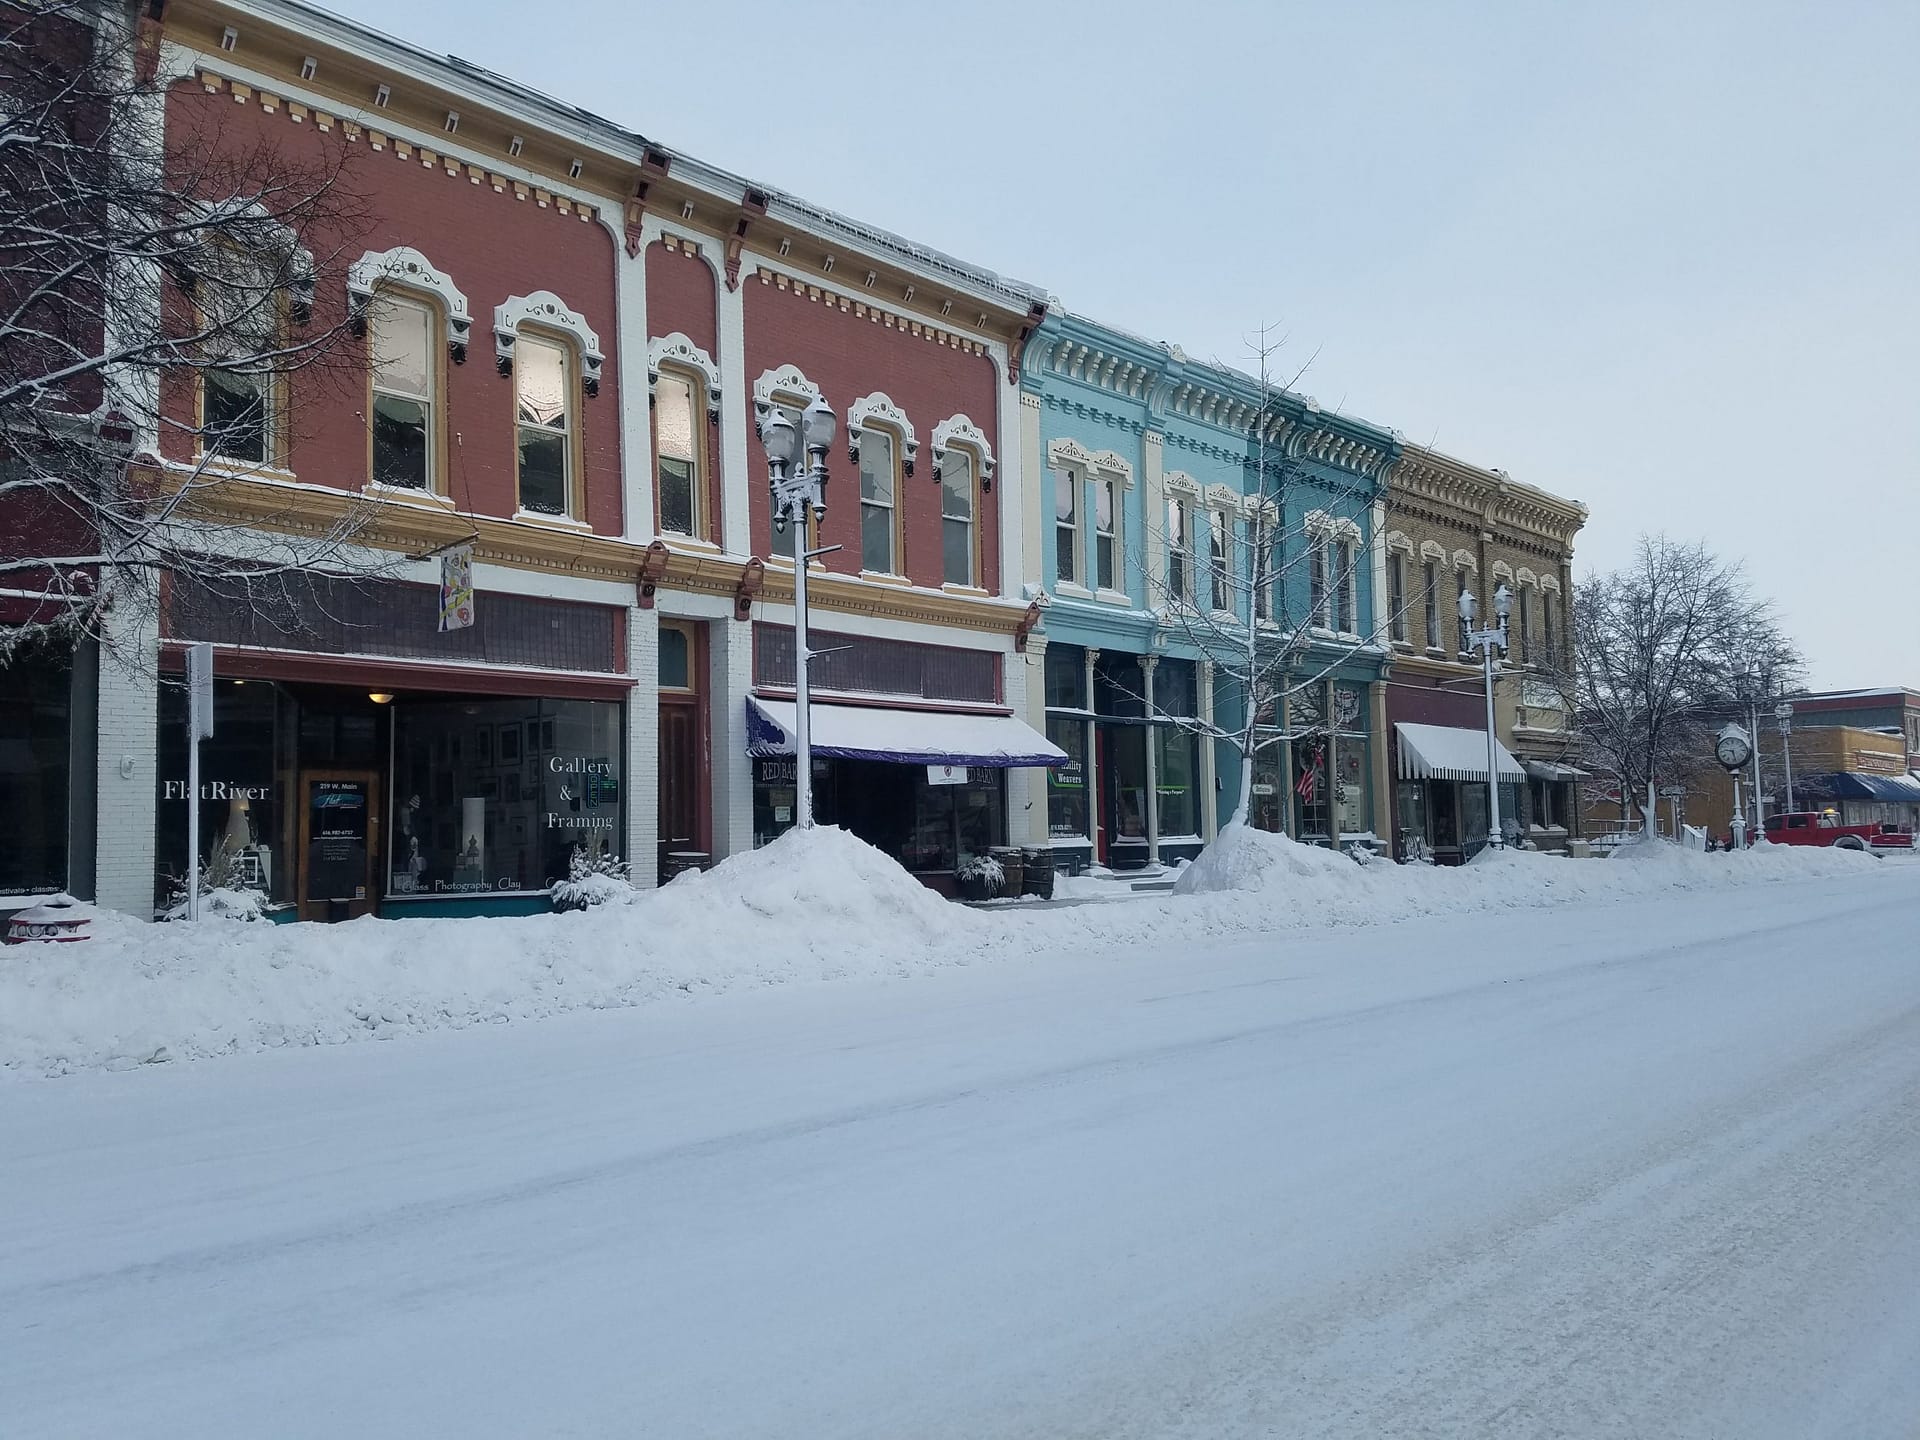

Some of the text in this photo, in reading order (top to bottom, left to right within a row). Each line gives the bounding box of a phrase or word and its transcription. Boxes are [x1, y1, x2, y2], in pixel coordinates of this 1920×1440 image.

[549, 757, 613, 777] Gallery
[762, 762, 797, 781] RED BAR
[1057, 773, 1082, 783] Weavers
[560, 784, 573, 801] &
[547, 812, 614, 831] Framing
[434, 878, 492, 893] Photography
[498, 877, 521, 890] Clay
